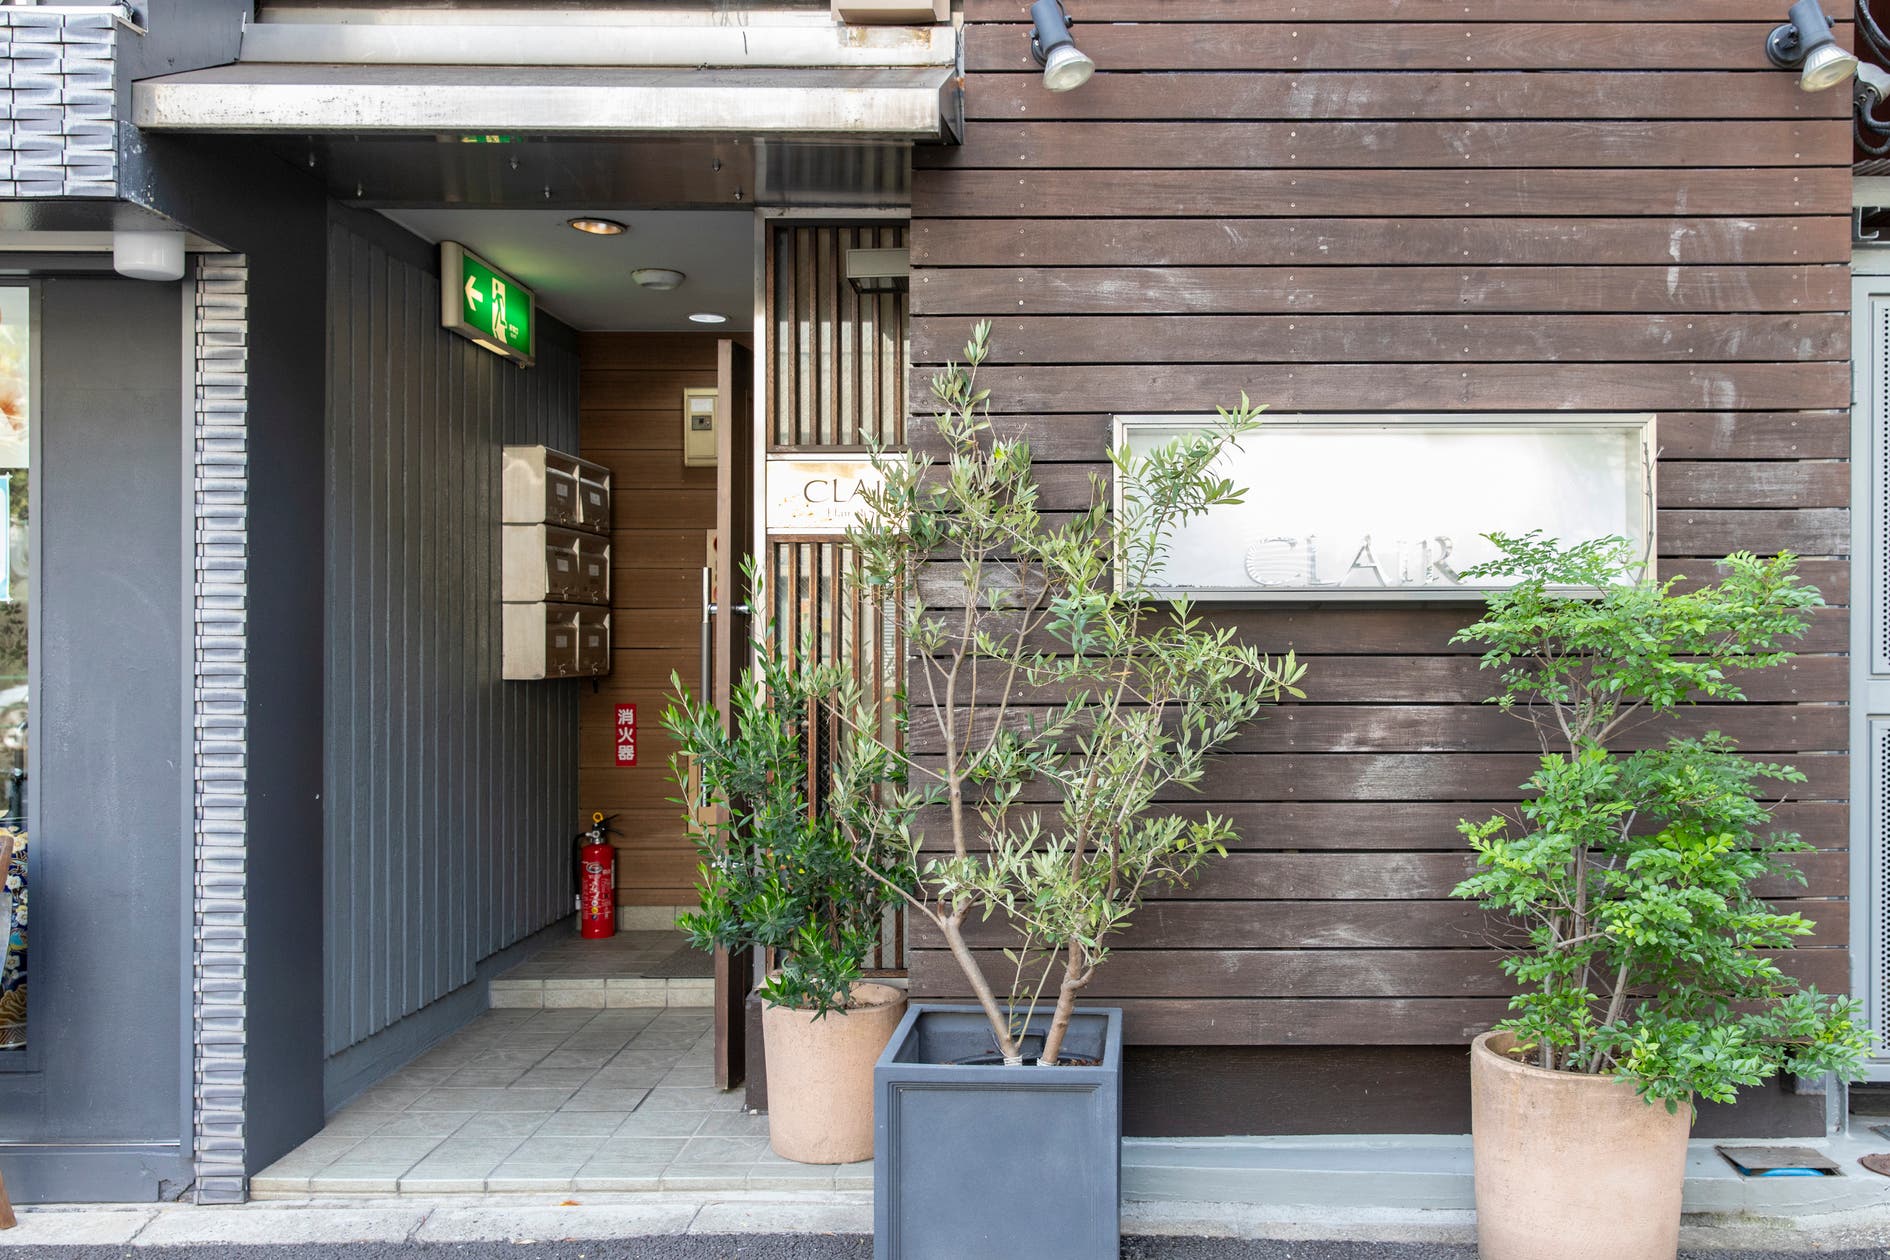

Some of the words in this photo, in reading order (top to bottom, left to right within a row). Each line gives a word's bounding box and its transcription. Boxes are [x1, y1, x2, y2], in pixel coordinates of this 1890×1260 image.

[803, 478, 882, 503] CLAI
[1245, 534, 1467, 587] CLAIR
[617, 708, 635, 761] 消火器
